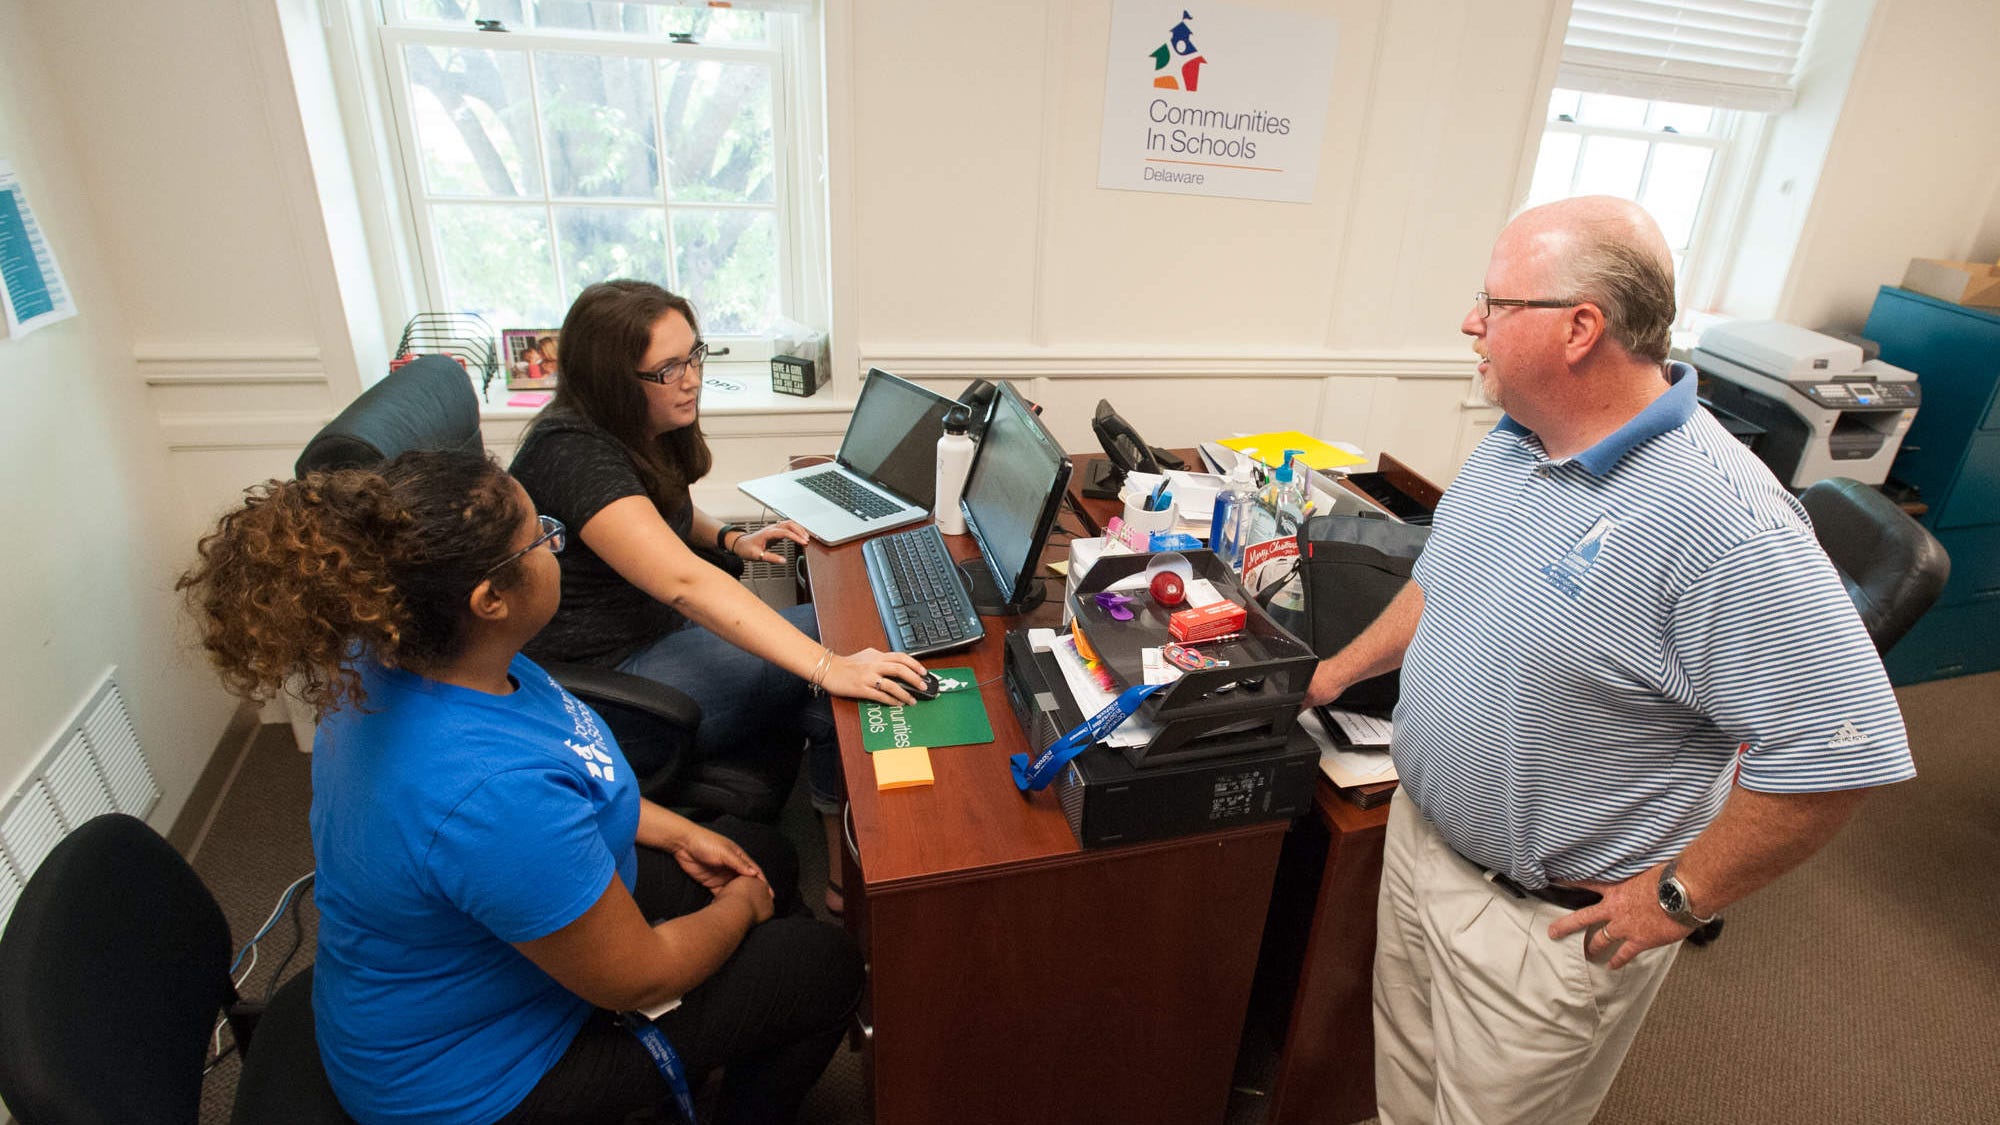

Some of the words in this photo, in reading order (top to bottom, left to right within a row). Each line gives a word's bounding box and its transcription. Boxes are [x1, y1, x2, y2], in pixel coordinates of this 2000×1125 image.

[1149, 99, 1291, 135] Communities
[1146, 128, 1166, 151] In
[1170, 129, 1256, 159] Schools
[1143, 166, 1205, 185] Delaware
